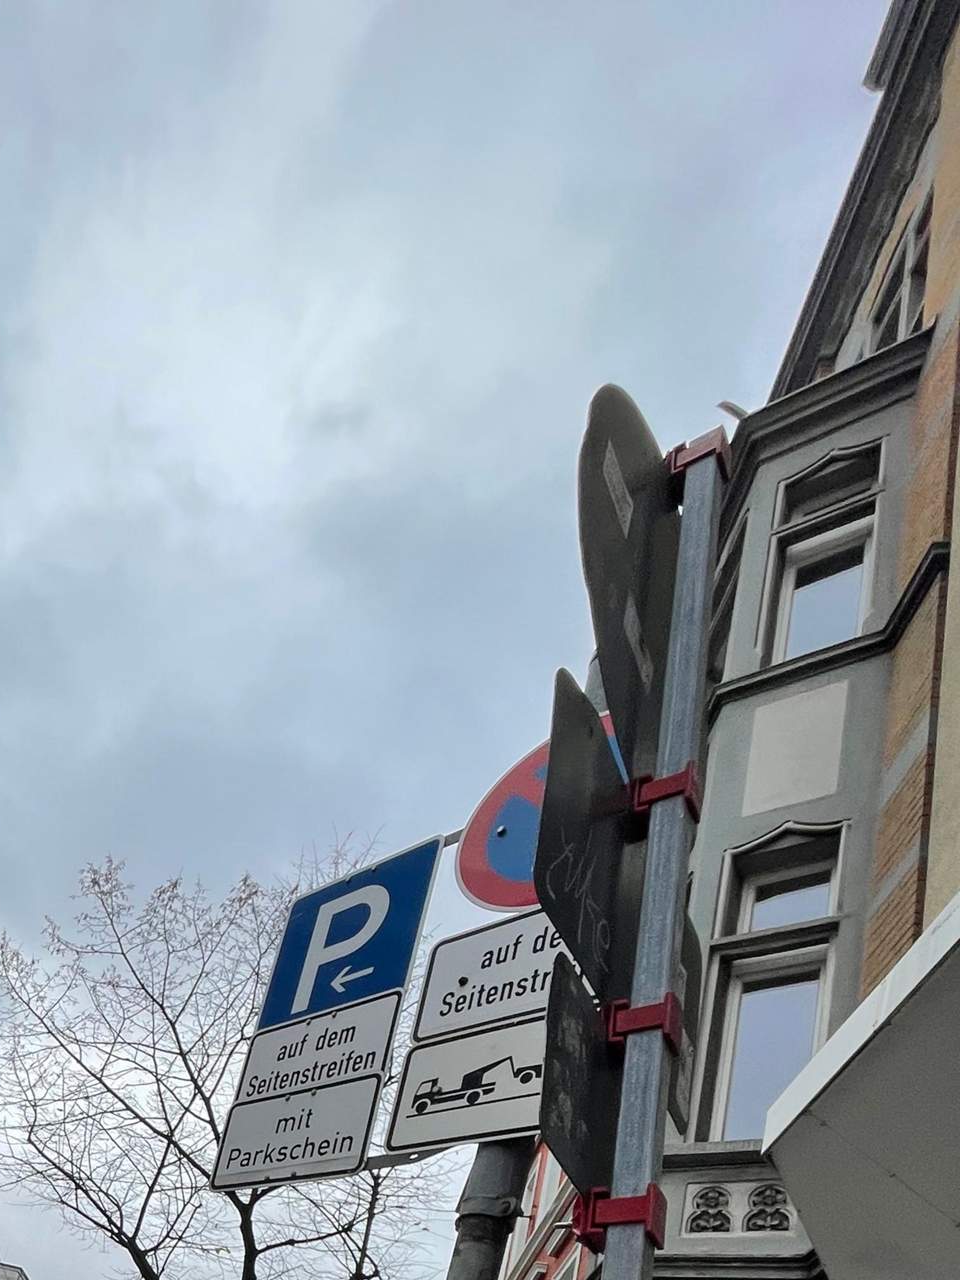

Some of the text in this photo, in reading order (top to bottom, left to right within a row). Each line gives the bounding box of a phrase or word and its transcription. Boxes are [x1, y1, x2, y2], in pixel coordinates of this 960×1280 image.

[481, 925, 563, 970] auf de
[439, 970, 551, 1018] Seitenstr
[276, 1024, 356, 1063] auf dem
[246, 1048, 376, 1098] Seitenstreifen
[275, 1109, 313, 1135] mit
[226, 1132, 355, 1170] Parkschein
